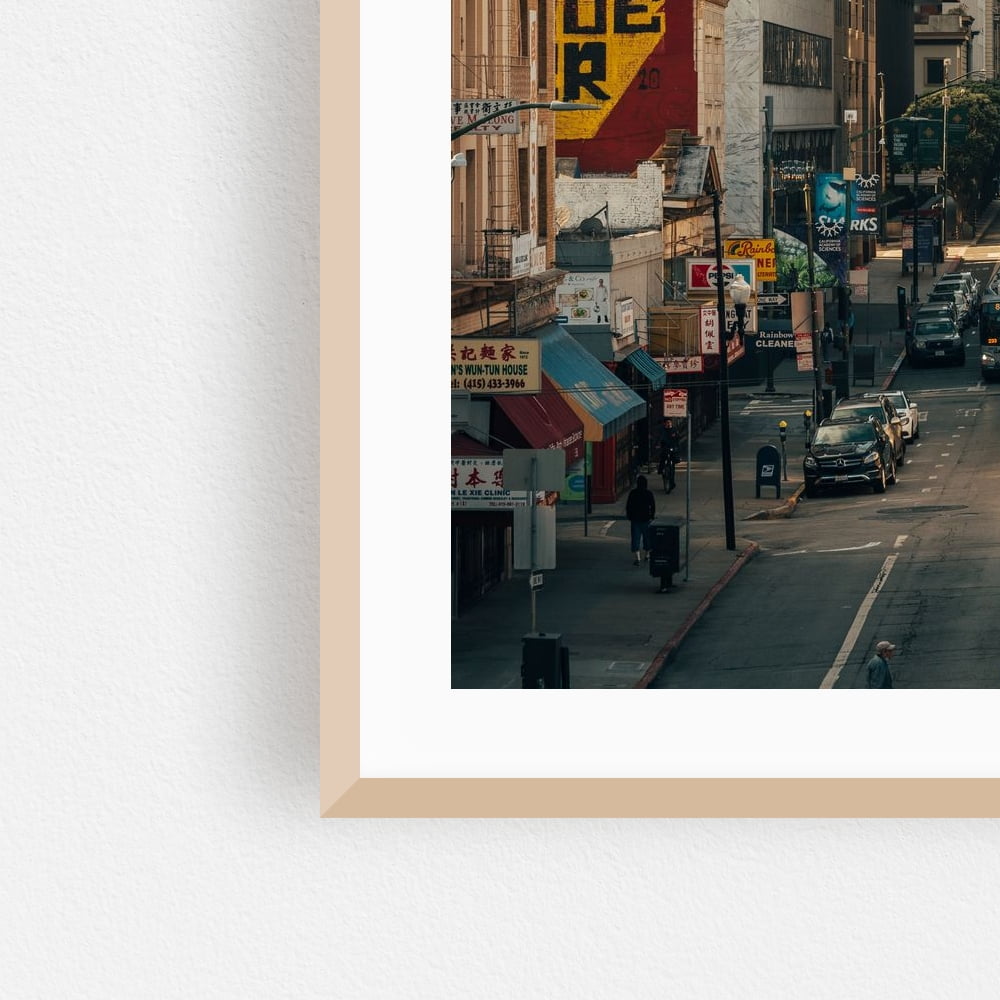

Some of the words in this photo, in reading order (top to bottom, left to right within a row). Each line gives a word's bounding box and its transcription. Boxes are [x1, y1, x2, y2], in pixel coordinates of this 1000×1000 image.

[555, 42, 611, 101] R
[488, 115, 515, 125] ONG
[850, 217, 878, 231] RKS
[759, 330, 794, 339] Rainbow
[465, 364, 500, 376] WUN-TUN
[502, 364, 528, 376] HOUSE
[463, 377, 486, 390] (415)
[487, 378, 526, 389] 433-3966
